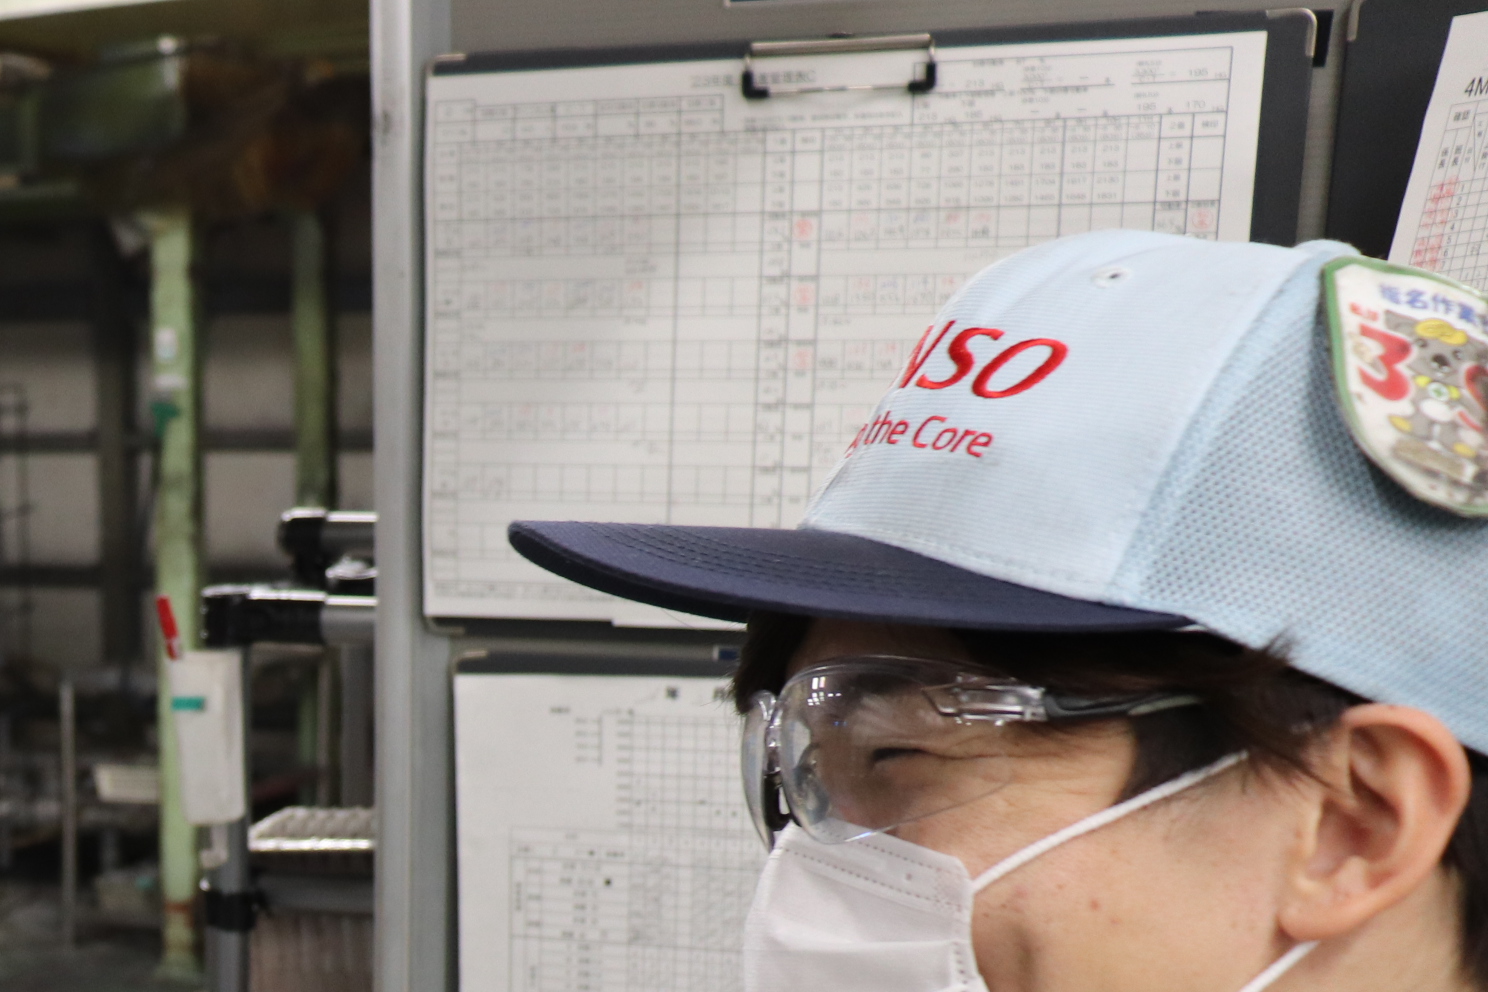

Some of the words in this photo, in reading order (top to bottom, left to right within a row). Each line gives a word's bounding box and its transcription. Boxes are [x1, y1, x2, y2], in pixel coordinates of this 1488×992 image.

[896, 320, 1070, 400] NSO
[863, 410, 911, 446] the
[912, 415, 994, 459] Core
